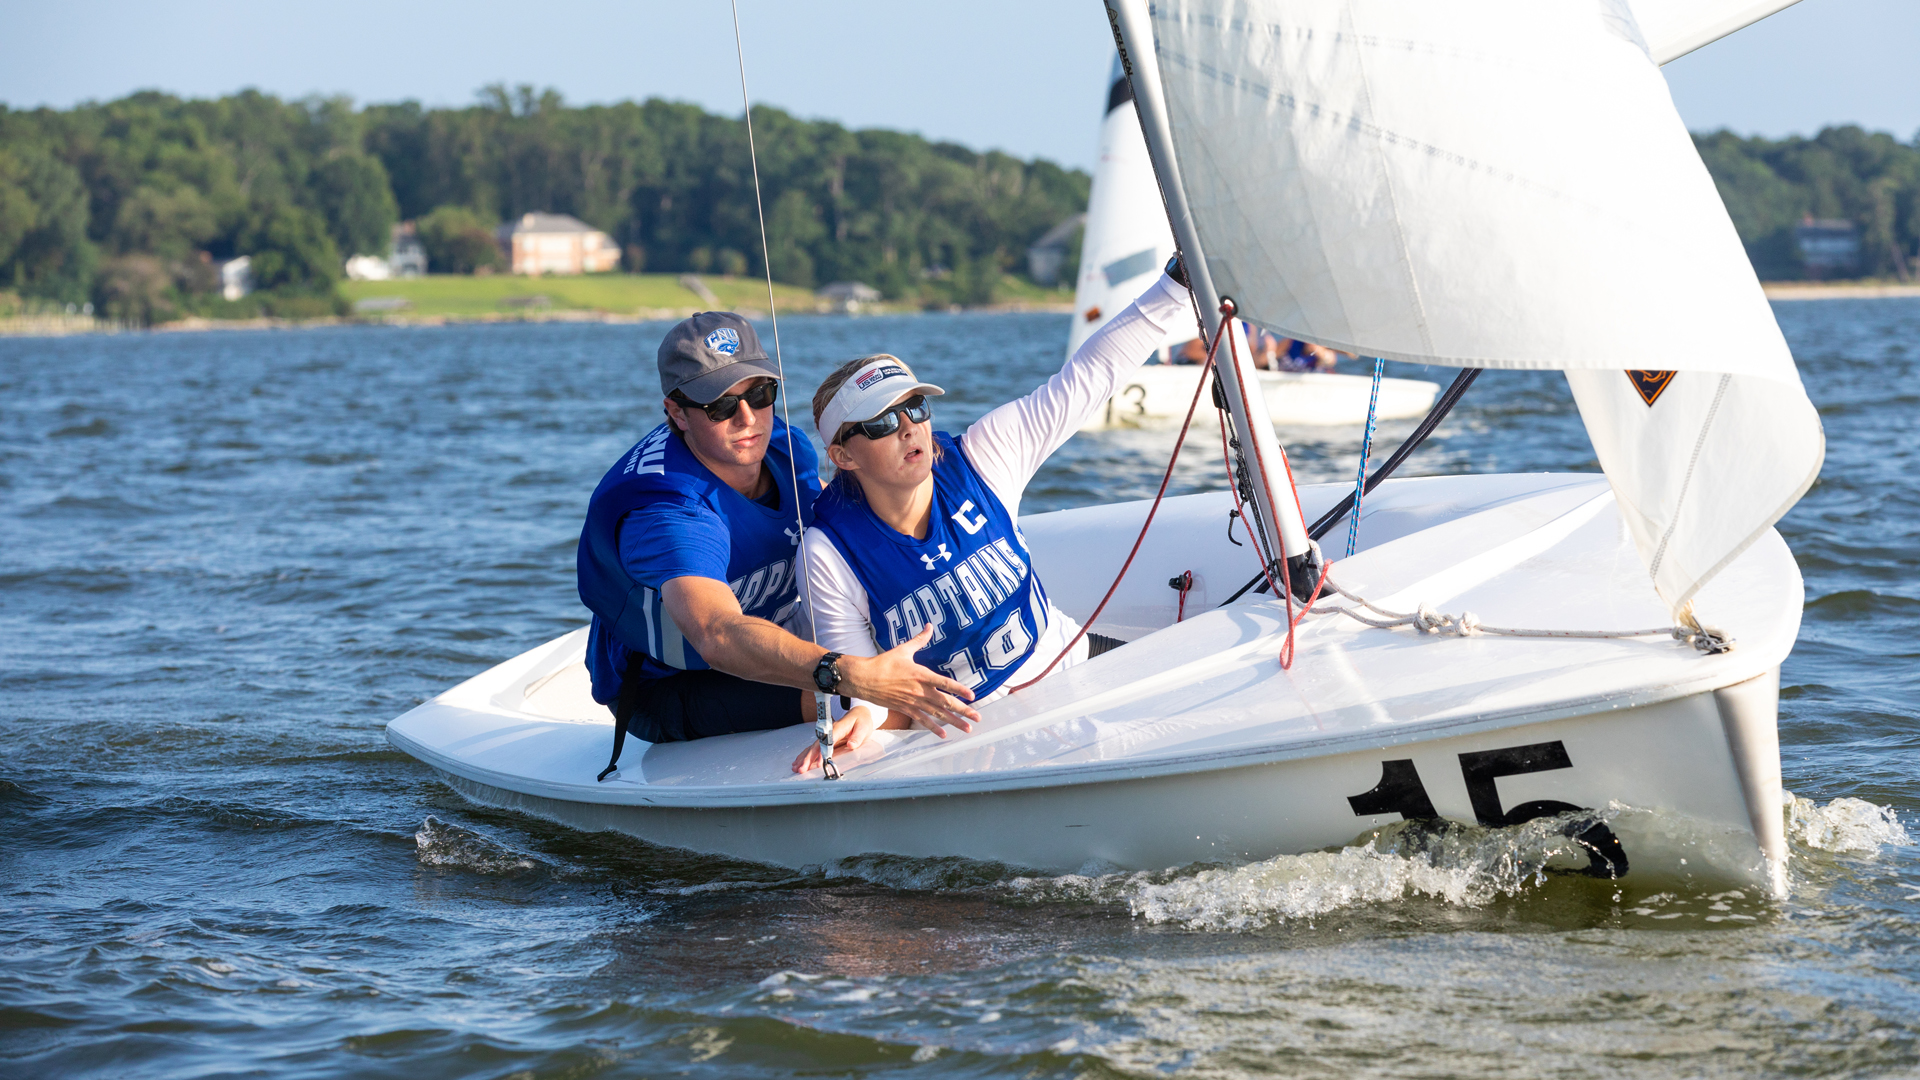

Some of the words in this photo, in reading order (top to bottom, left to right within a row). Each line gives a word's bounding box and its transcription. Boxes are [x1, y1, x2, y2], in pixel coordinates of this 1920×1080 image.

[704, 329, 739, 349] CNU
[951, 499, 988, 535] C
[883, 537, 1028, 651] CAPTAINS
[938, 607, 1033, 696] 10
[1347, 740, 1629, 879] 15
